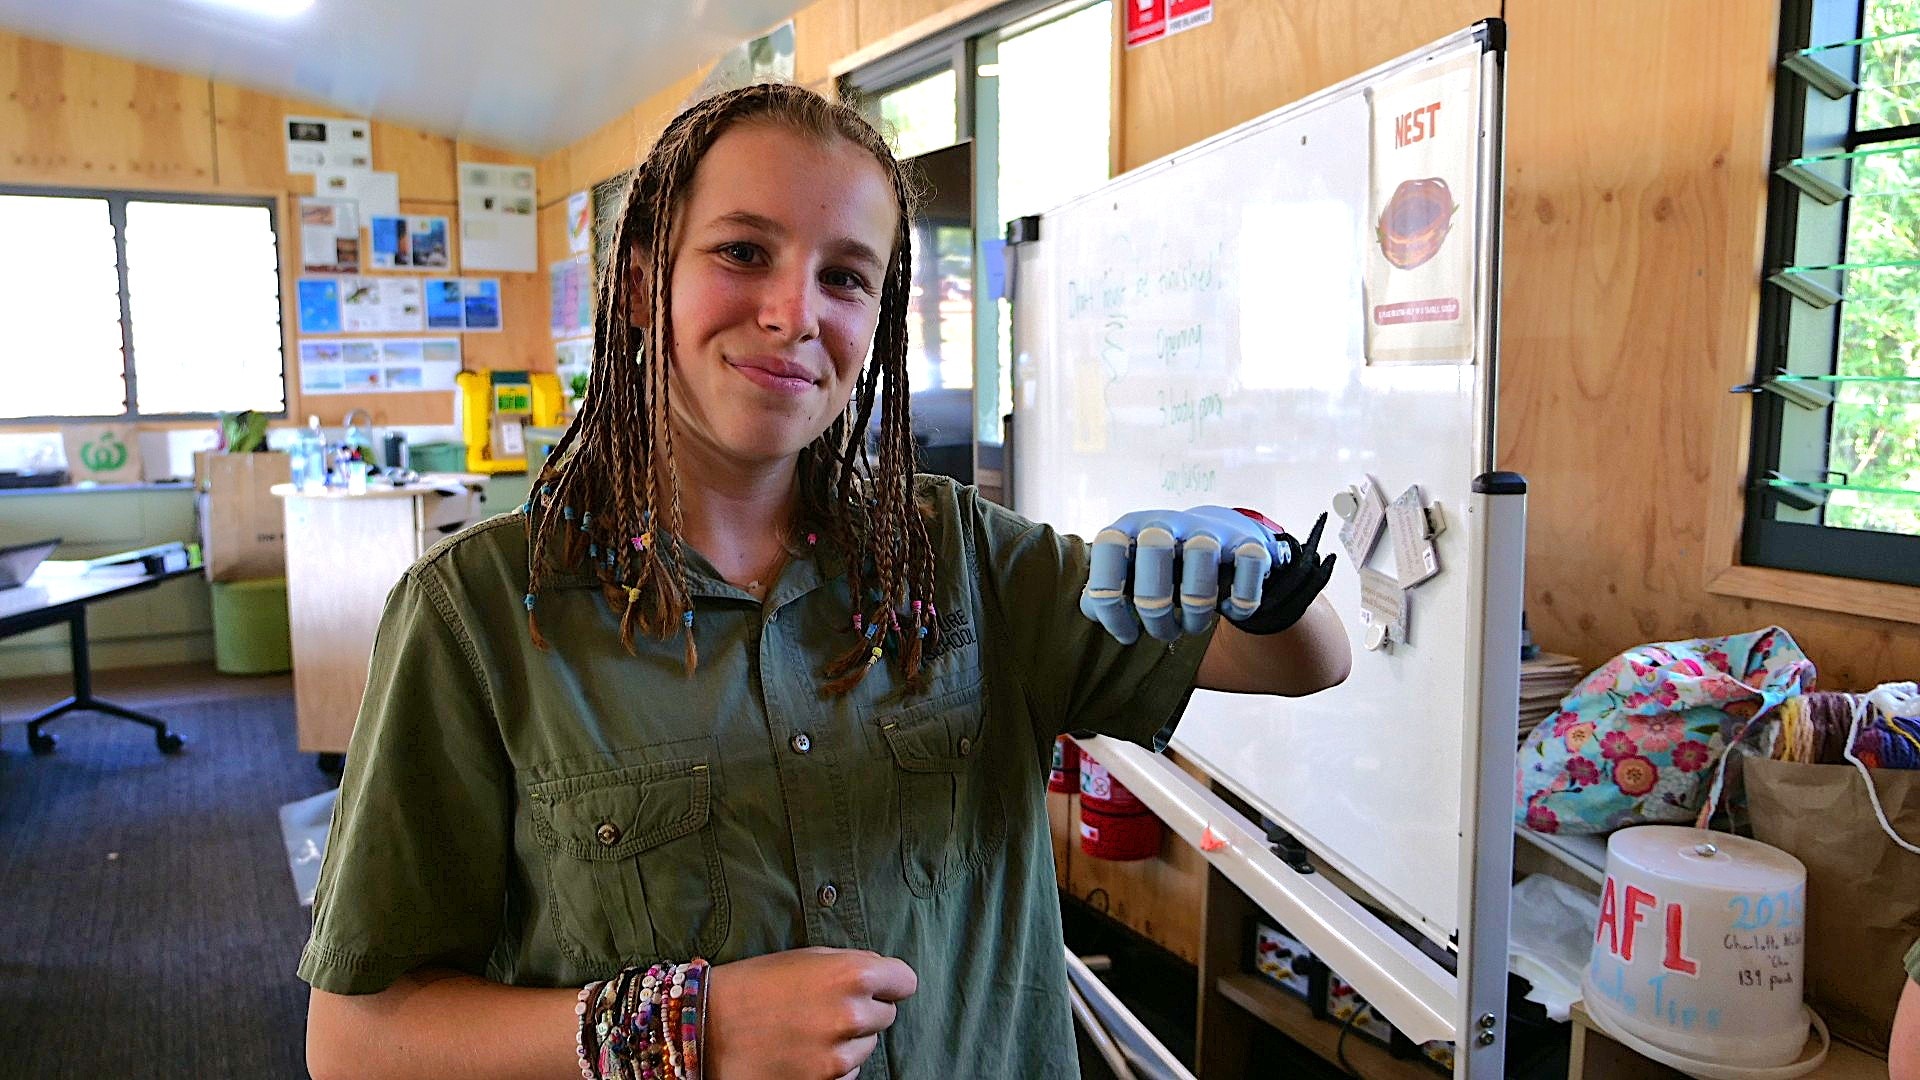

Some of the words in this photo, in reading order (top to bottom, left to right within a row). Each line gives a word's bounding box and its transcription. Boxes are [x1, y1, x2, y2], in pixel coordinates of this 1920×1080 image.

[1394, 101, 1443, 150] NEST
[1596, 876, 1698, 976] AFL
[1738, 970, 1762, 986] 139
